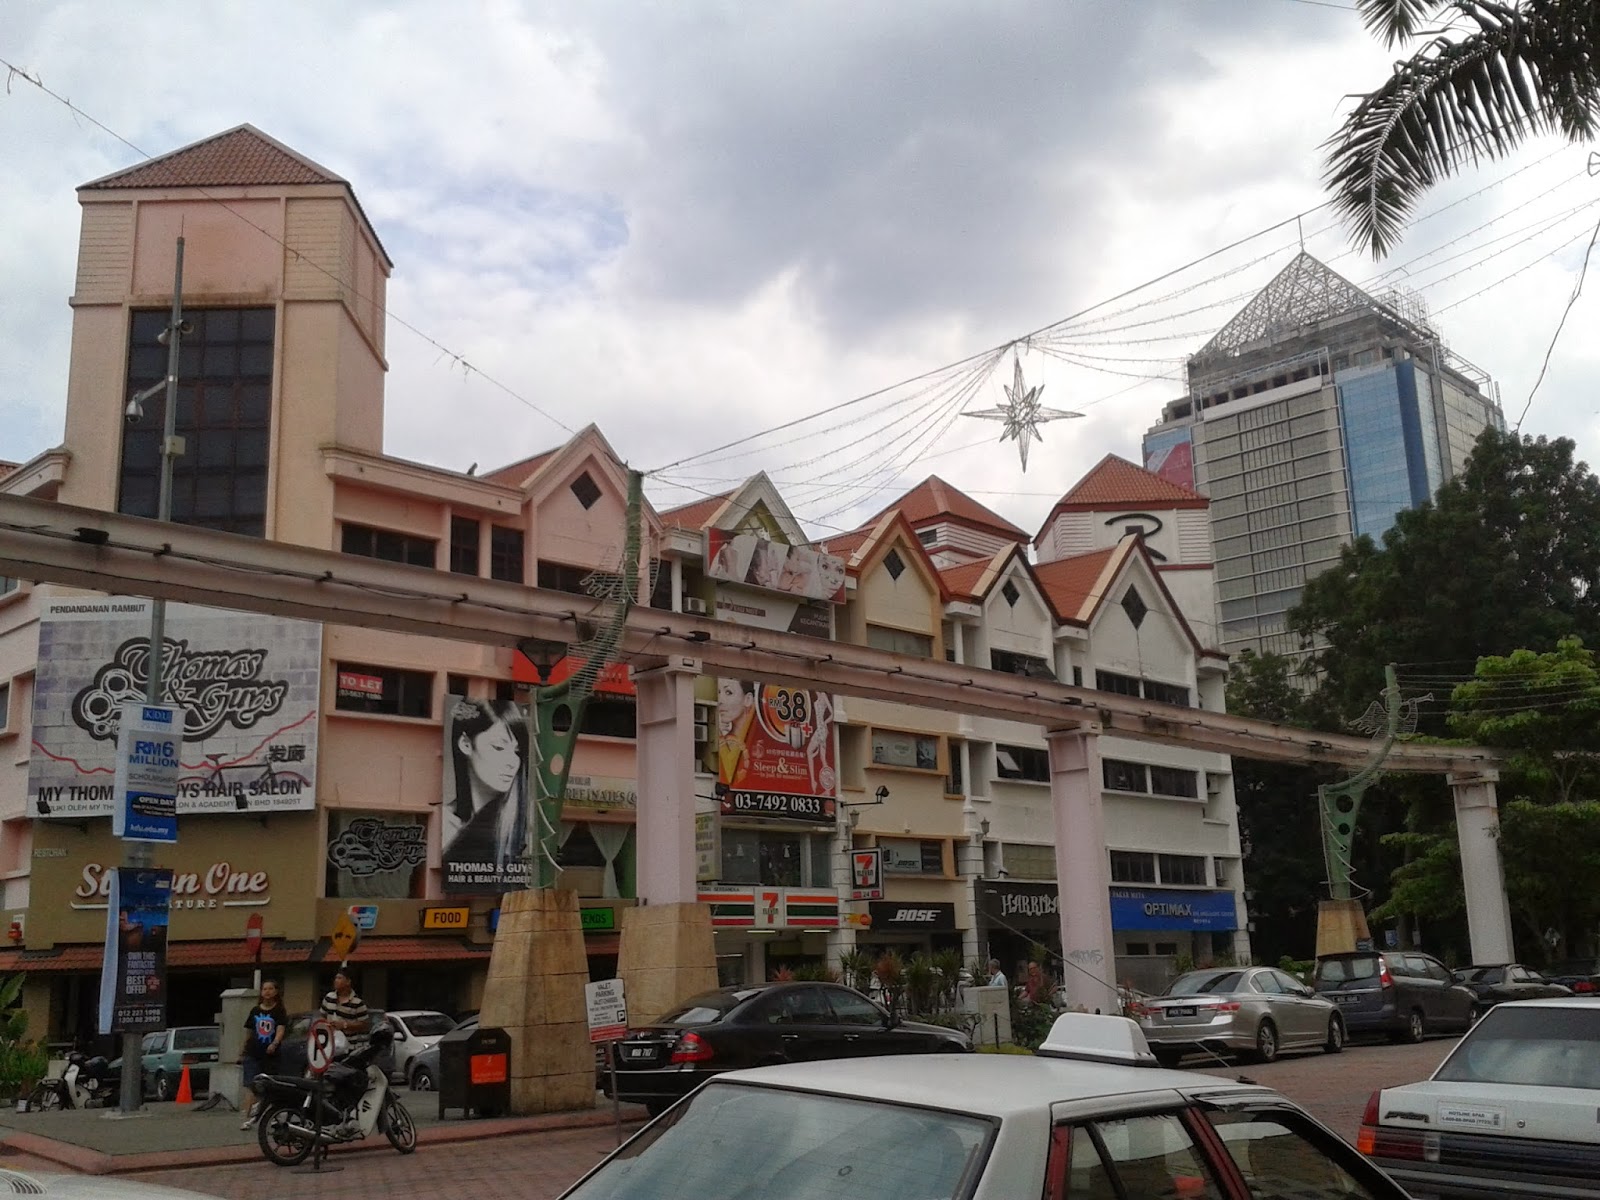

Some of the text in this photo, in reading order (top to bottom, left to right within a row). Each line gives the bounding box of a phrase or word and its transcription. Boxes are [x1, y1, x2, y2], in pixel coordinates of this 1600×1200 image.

[50, 604, 146, 614] PENDANDANAN RAMBUT
[121, 643, 263, 684] Thomas
[340, 675, 381, 690] TO LET
[199, 682, 287, 725] Guys
[777, 689, 807, 722] 38
[145, 711, 169, 720] KDU
[135, 740, 175, 758] RM6
[129, 754, 179, 768] MILLION
[753, 757, 808, 775] Sleep & Slim
[38, 786, 64, 802] MY
[69, 785, 114, 801] THOM
[204, 781, 243, 797] HAIR
[248, 779, 302, 796] SALON
[139, 796, 158, 804] OPEN
[160, 798, 175, 806] DAY
[198, 800, 235, 808] ACADEMY
[735, 793, 820, 814] 03-7492 0833
[33, 848, 68, 857] RESTORAN
[449, 862, 532, 873] THOMAS & GUYS
[205, 862, 269, 897] One
[448, 875, 465, 883] HAIR
[467, 875, 473, 883] &
[474, 875, 501, 883] BEAUTY
[888, 909, 941, 922] BOSE
[1144, 902, 1192, 917] OPTIMAX
[432, 911, 461, 924] FOOD
[126, 975, 146, 985] BEST
[126, 985, 147, 995] OFFER
[313, 1028, 329, 1061] P
